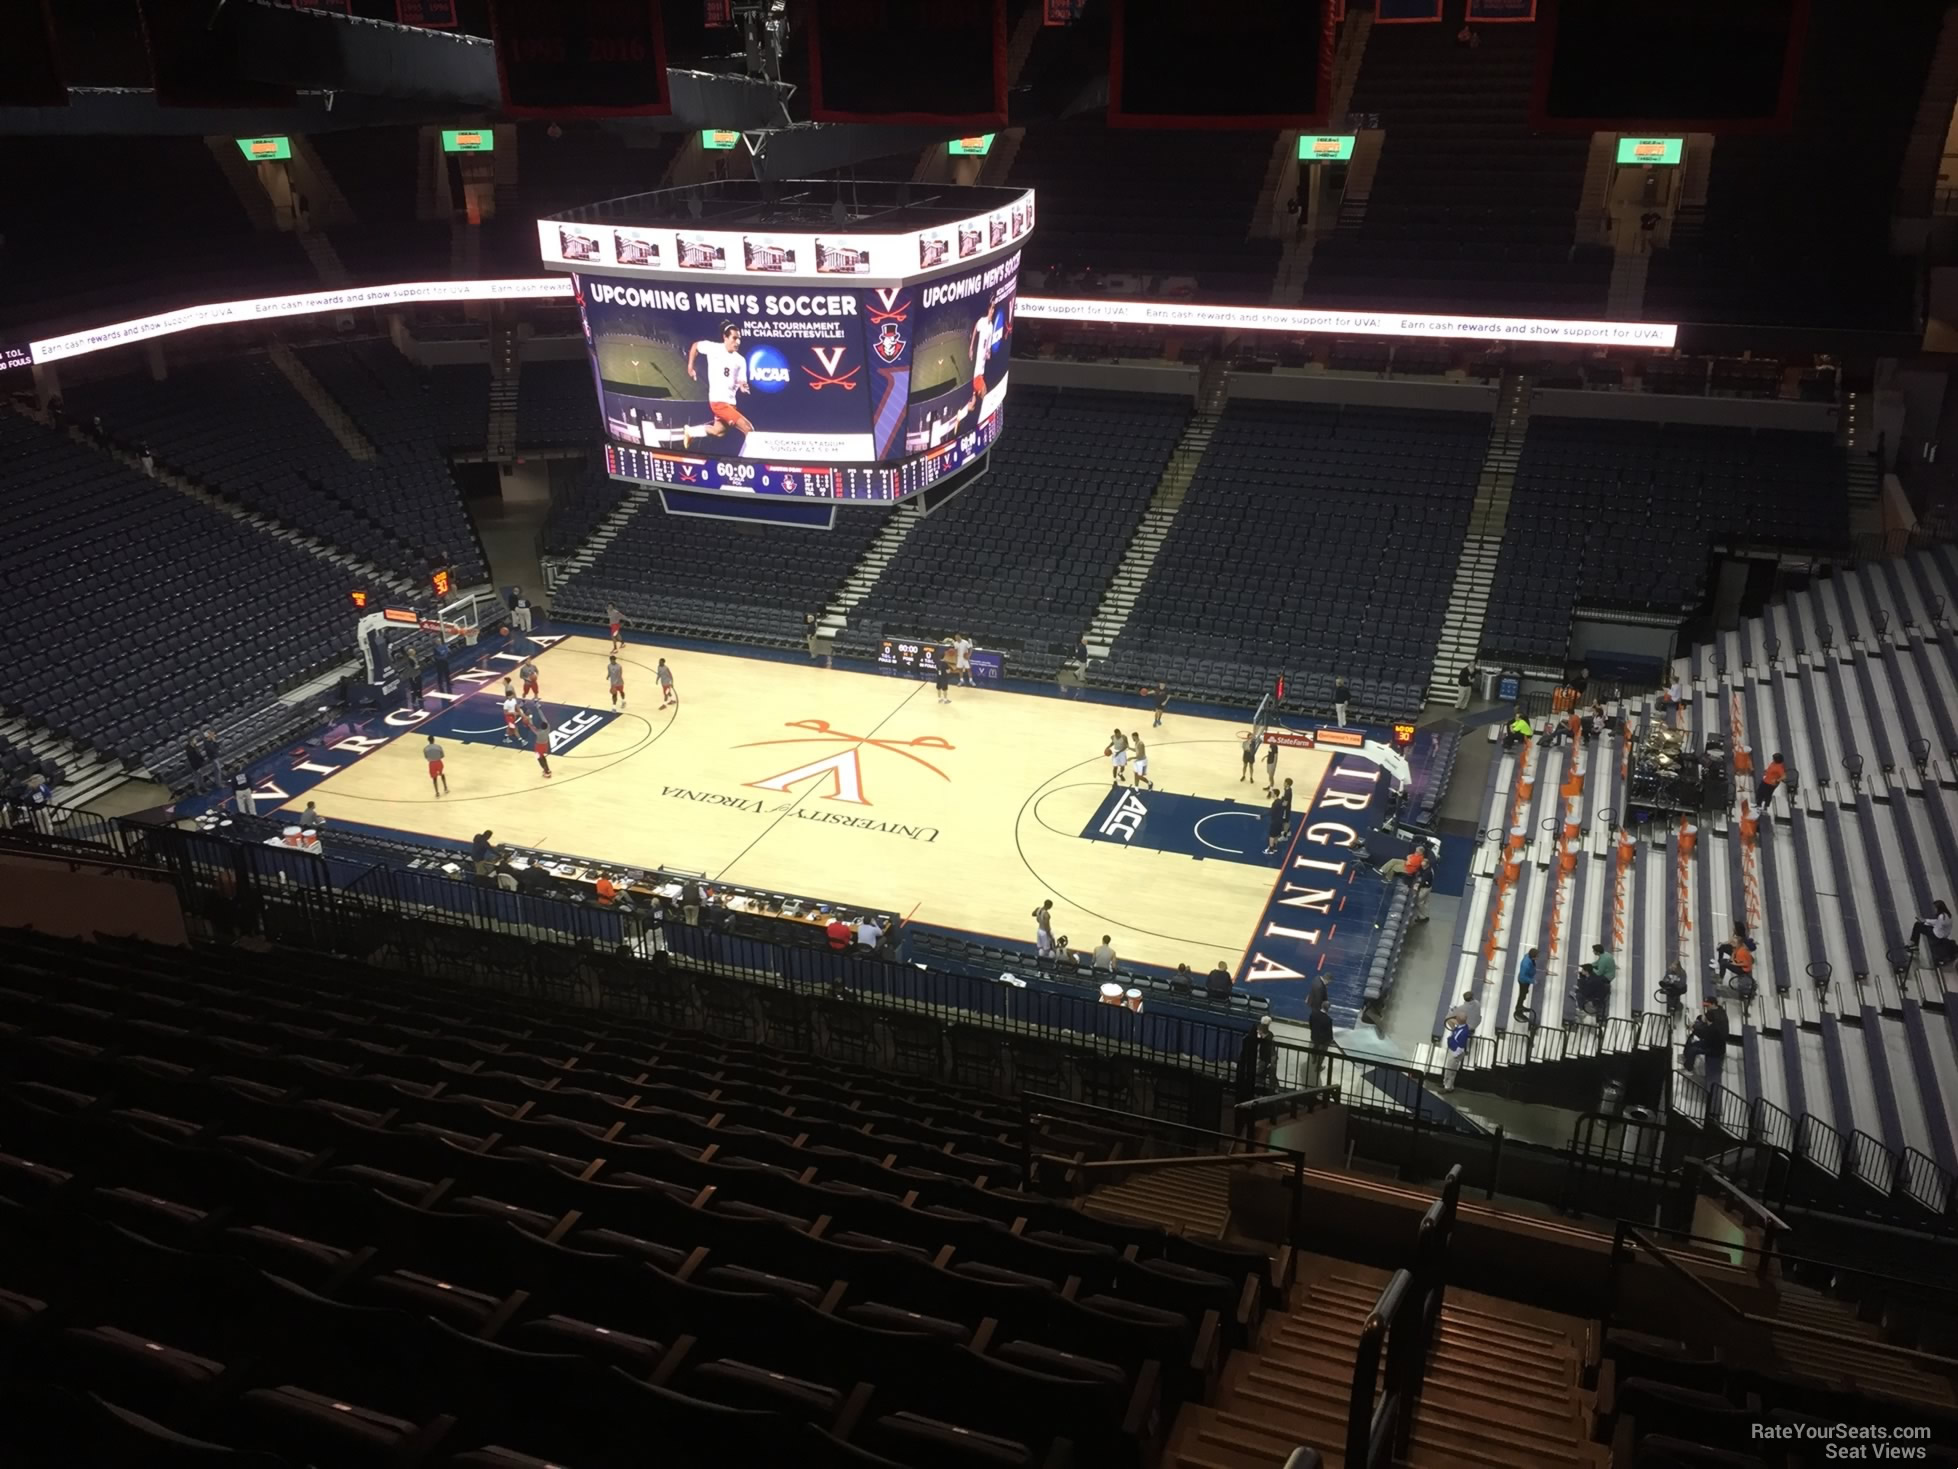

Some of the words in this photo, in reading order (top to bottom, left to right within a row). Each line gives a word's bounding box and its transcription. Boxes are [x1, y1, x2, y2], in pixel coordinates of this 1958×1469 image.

[590, 283, 691, 311] UPCOMING
[695, 292, 760, 315] MEN'S
[764, 295, 858, 317] SOCCER
[923, 275, 982, 308] UPCOMING
[254, 304, 278, 313] Earn
[306, 295, 344, 307] rewards
[347, 294, 364, 303] and
[367, 291, 390, 301] show
[1021, 303, 1045, 312] show
[1048, 305, 1084, 315] support
[743, 320, 770, 330] NCAA
[773, 321, 841, 331] TOURNAMENT
[1146, 308, 1169, 318] Earn
[1171, 310, 1193, 319] cash
[1197, 311, 1236, 321] rewards
[1239, 313, 1259, 322] and
[1262, 314, 1288, 323] show
[1292, 316, 1332, 326] support
[1335, 316, 1350, 326] for
[87, 330, 122, 344] rewards
[124, 326, 139, 337] and
[140, 322, 161, 333] show
[741, 328, 752, 336] IN
[753, 329, 845, 339] CHARLOTTESVILLE!
[1401, 320, 1425, 329] Earn
[1429, 321, 1454, 330] cash
[1457, 322, 1502, 333] rewards
[1505, 324, 1527, 334] and
[1530, 325, 1560, 335] show
[1563, 328, 1609, 338] support
[1613, 328, 1630, 338] for
[750, 367, 791, 382] NCAA
[701, 469, 709, 481] 0
[716, 462, 756, 480] 60:00
[762, 475, 770, 487] 0
[436, 580, 448, 595] 30
[884, 646, 891, 654] 0
[925, 651, 932, 659] 0
[250, 634, 566, 800] VIRGINIA
[548, 710, 599, 750] ACC
[1399, 733, 1410, 741] 30
[661, 786, 764, 814] VIRGINIA
[788, 808, 940, 843] UNIVERSITY
[1104, 795, 1148, 842] ACC
